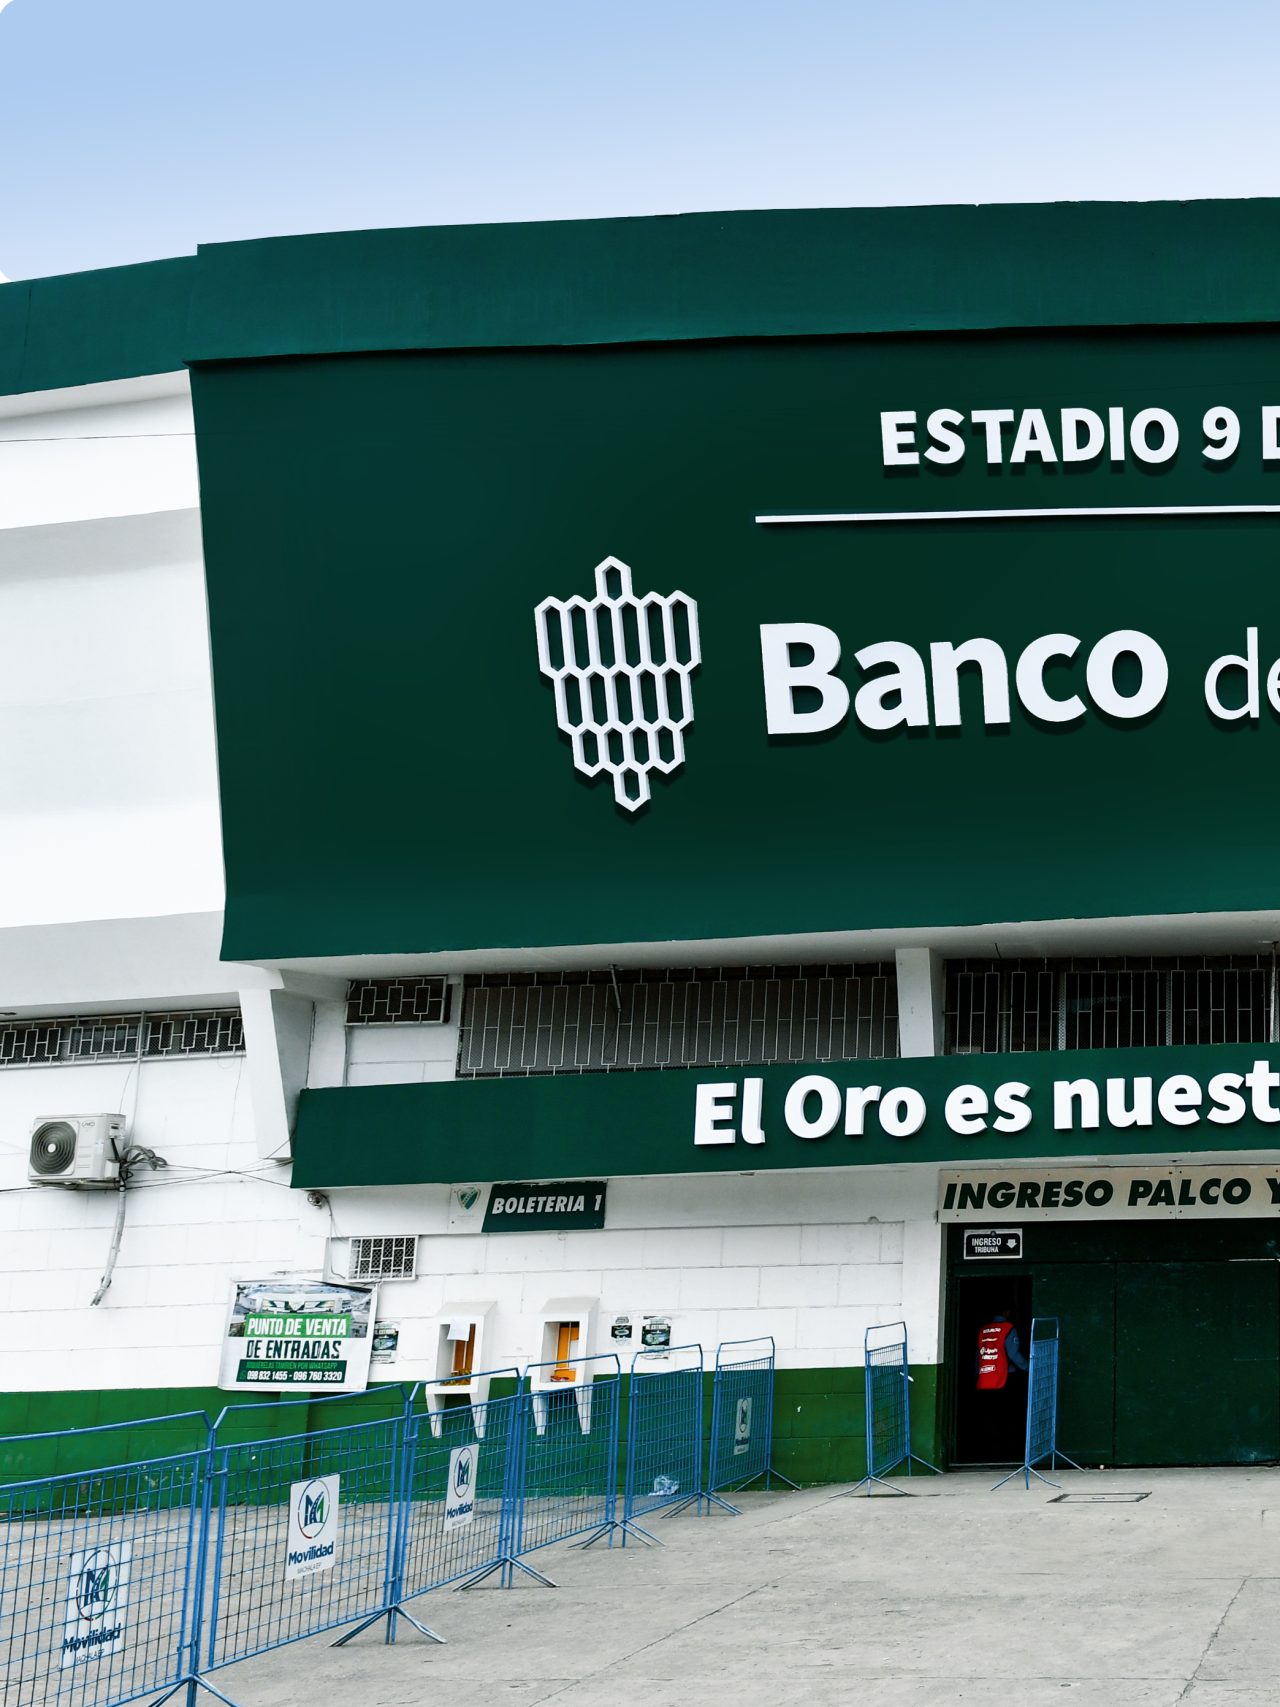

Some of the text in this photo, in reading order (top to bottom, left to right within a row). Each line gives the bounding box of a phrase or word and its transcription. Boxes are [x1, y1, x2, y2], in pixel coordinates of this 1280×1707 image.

[880, 407, 1179, 466] ESTADIO
[1201, 405, 1241, 461] 9
[760, 622, 1169, 735] Banco
[693, 1077, 766, 1145] El
[784, 1074, 927, 1139] Oro
[944, 1081, 1032, 1136] es
[491, 1194, 602, 1214] BOLETERIA 1
[943, 1180, 1114, 1210] INGRESO
[1128, 1178, 1252, 1206] PALCO
[971, 1237, 1002, 1246] INGRESO
[247, 1318, 348, 1336] PUNTO DE VENTA
[246, 1340, 341, 1359] DE ENTRADAS
[272, 1370, 288, 1380] 1455
[293, 1371, 307, 1381] 096
[308, 1371, 323, 1381] 760
[323, 1371, 343, 1381] 3320
[288, 1541, 334, 1566] Movilidad
[63, 1623, 121, 1654] Movilidad
